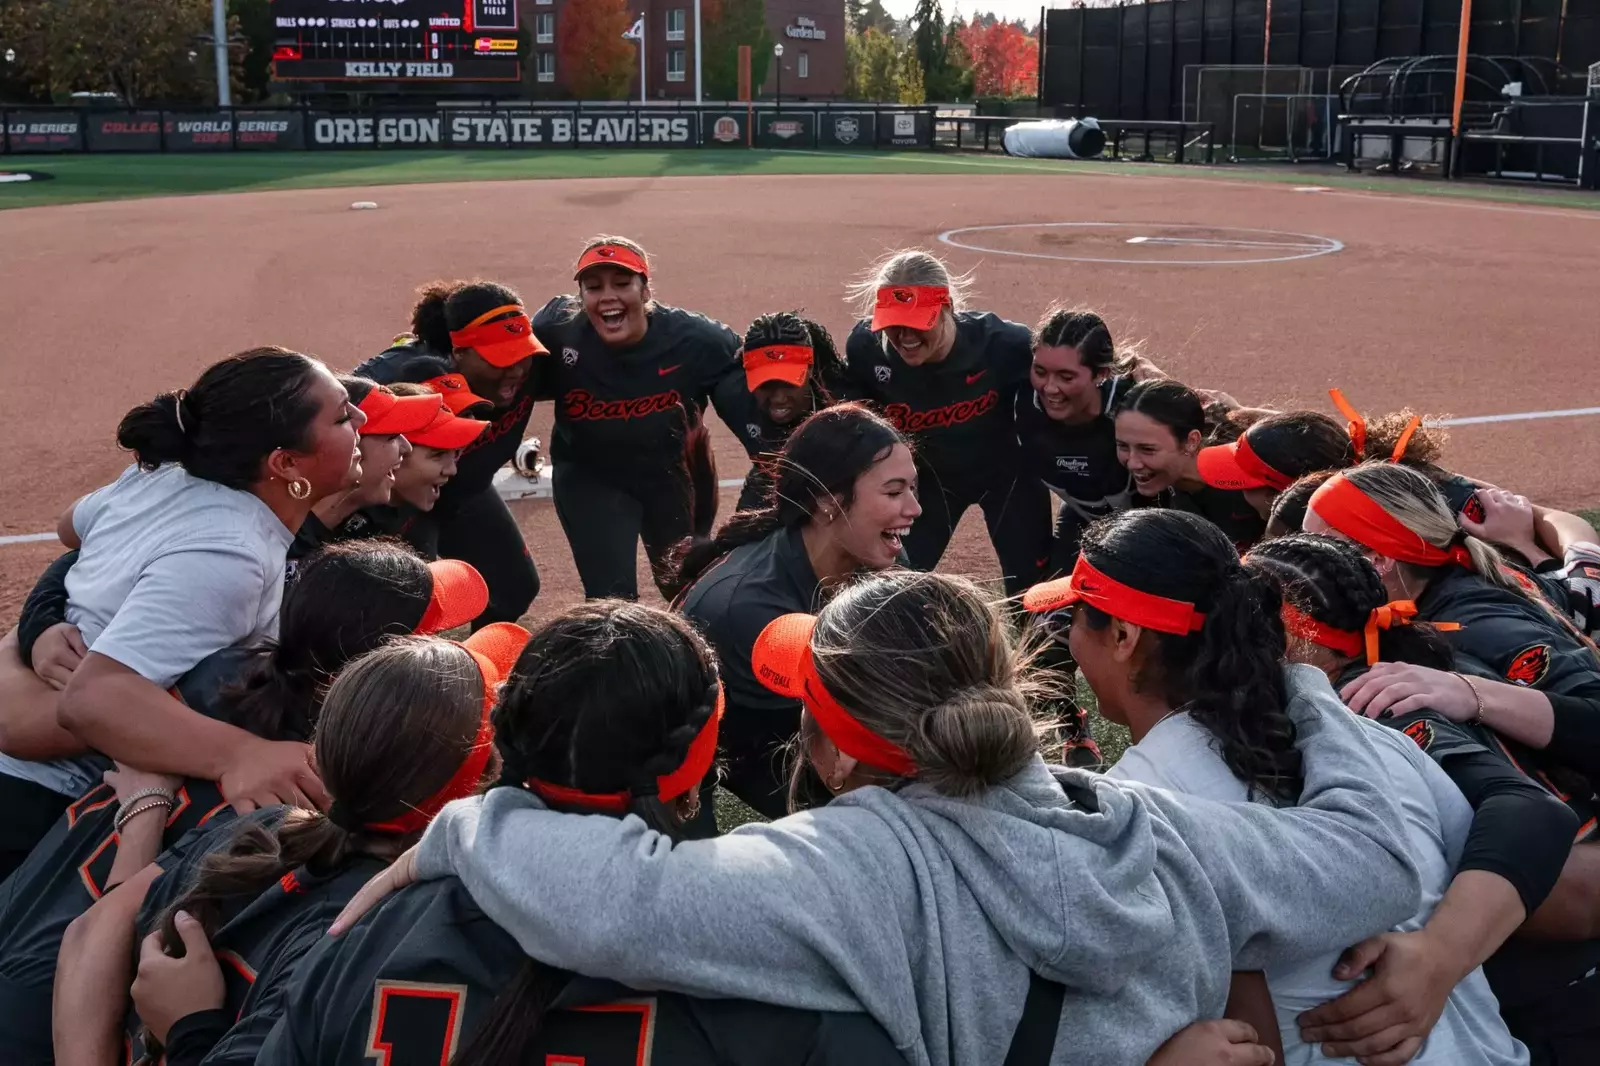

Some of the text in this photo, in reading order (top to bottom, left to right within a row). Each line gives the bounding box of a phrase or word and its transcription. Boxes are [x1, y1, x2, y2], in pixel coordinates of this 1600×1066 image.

[483, 6, 507, 15] FIELD
[276, 17, 297, 27] BALLS
[428, 17, 461, 27] UNITED
[344, 62, 454, 77] KELLY FIELD
[30, 123, 78, 134] SERIES
[178, 121, 232, 133] WORLD
[237, 121, 289, 132] SERIES
[314, 117, 440, 143] OREGON
[452, 117, 543, 142] STATE
[551, 117, 689, 142] BEAVERS
[891, 138, 918, 146] TOYOTA
[564, 388, 681, 422] Beavers
[884, 389, 999, 432] Beavers
[1056, 458, 1089, 471] Rawlings
[759, 663, 791, 689] SOFTBALL
